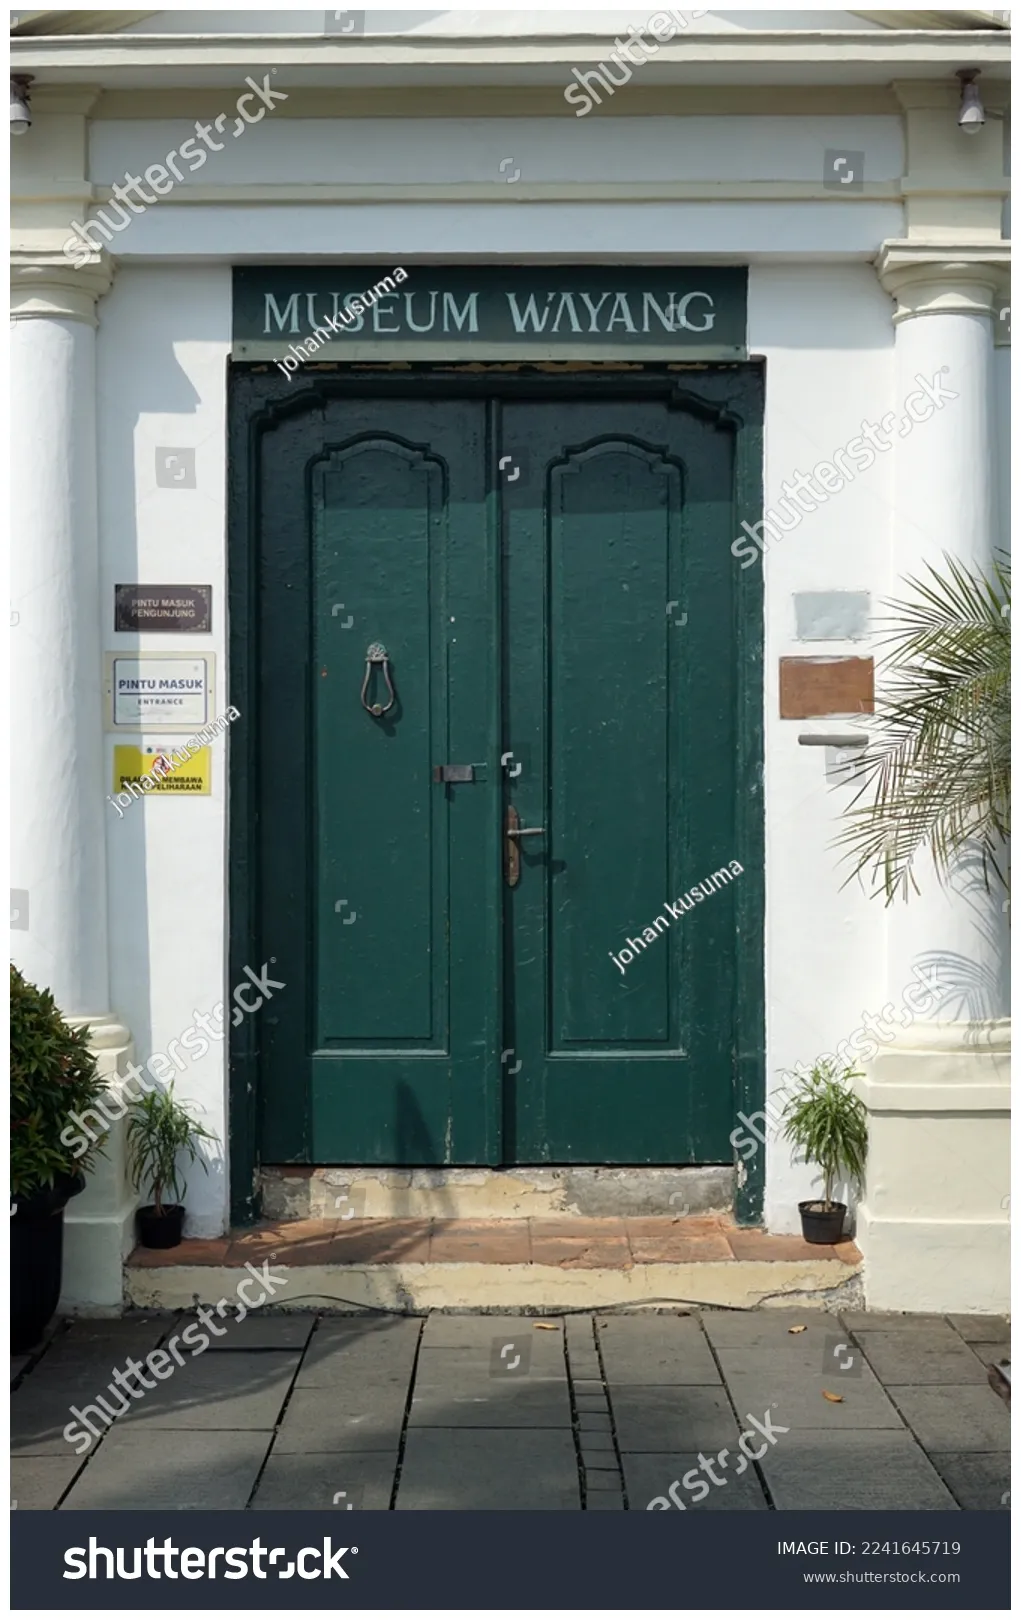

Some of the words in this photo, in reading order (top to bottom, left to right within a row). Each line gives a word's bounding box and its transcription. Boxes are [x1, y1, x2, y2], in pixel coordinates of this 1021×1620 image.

[263, 291, 479, 334] MUSEUM
[505, 291, 716, 333] WAYANG
[132, 609, 195, 617] PENGUNJUNG
[118, 679, 156, 689] PINTU
[159, 679, 203, 689] MASUK
